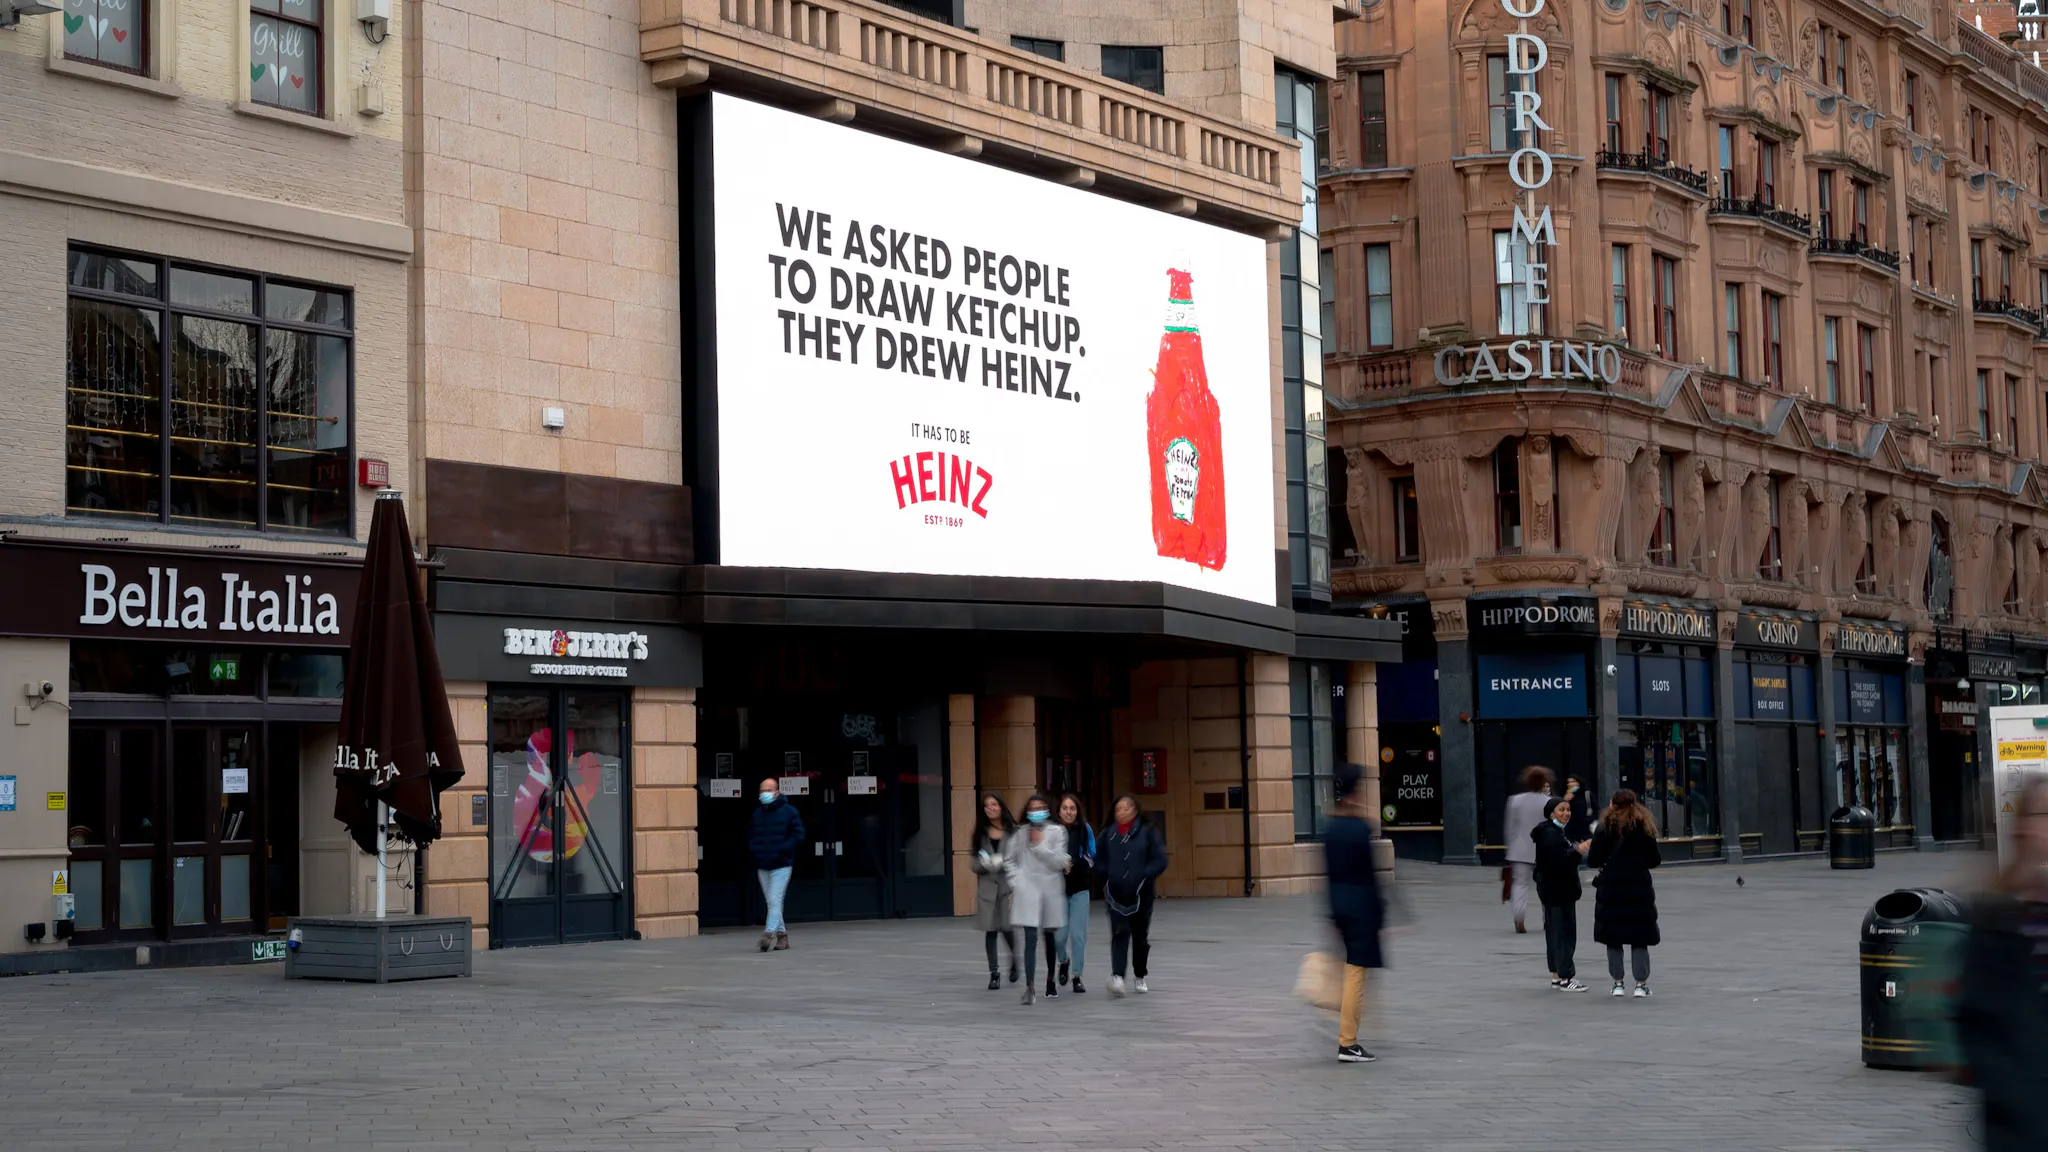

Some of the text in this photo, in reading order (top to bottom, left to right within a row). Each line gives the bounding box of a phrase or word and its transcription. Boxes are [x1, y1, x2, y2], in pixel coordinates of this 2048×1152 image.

[1502, 0, 1560, 304] DROME
[775, 202, 1070, 307] WE ASKED PEOPLE
[768, 254, 1086, 358] TO DRAW KETCHUP.
[778, 309, 1081, 404] THEY DREW HEINZ.
[1433, 339, 1621, 387] CASINO
[911, 422, 971, 445] IT HAS TO BE
[1171, 448, 1197, 467] HEINZ
[368, 464, 387, 475] ABEL
[889, 451, 993, 519] HEINZ
[945, 516, 964, 528] 1869
[79, 563, 340, 635] Bella Italia
[1482, 605, 1595, 627] HIPPODROME
[1626, 607, 1712, 638] HIPPODROME
[1758, 620, 1799, 646] CASINO
[1841, 629, 1905, 656] HIPPODROME
[530, 663, 564, 676] SCOOP
[563, 664, 587, 676] SHOP
[596, 666, 628, 677] COFFEE
[1490, 677, 1573, 691] ENTRANCE
[1652, 679, 1670, 692] SLOTS
[1757, 700, 1785, 711] BOX OFFICE
[2015, 743, 2046, 753] Warning
[1402, 774, 1429, 786] PLAY
[1398, 787, 1434, 800] POKER
